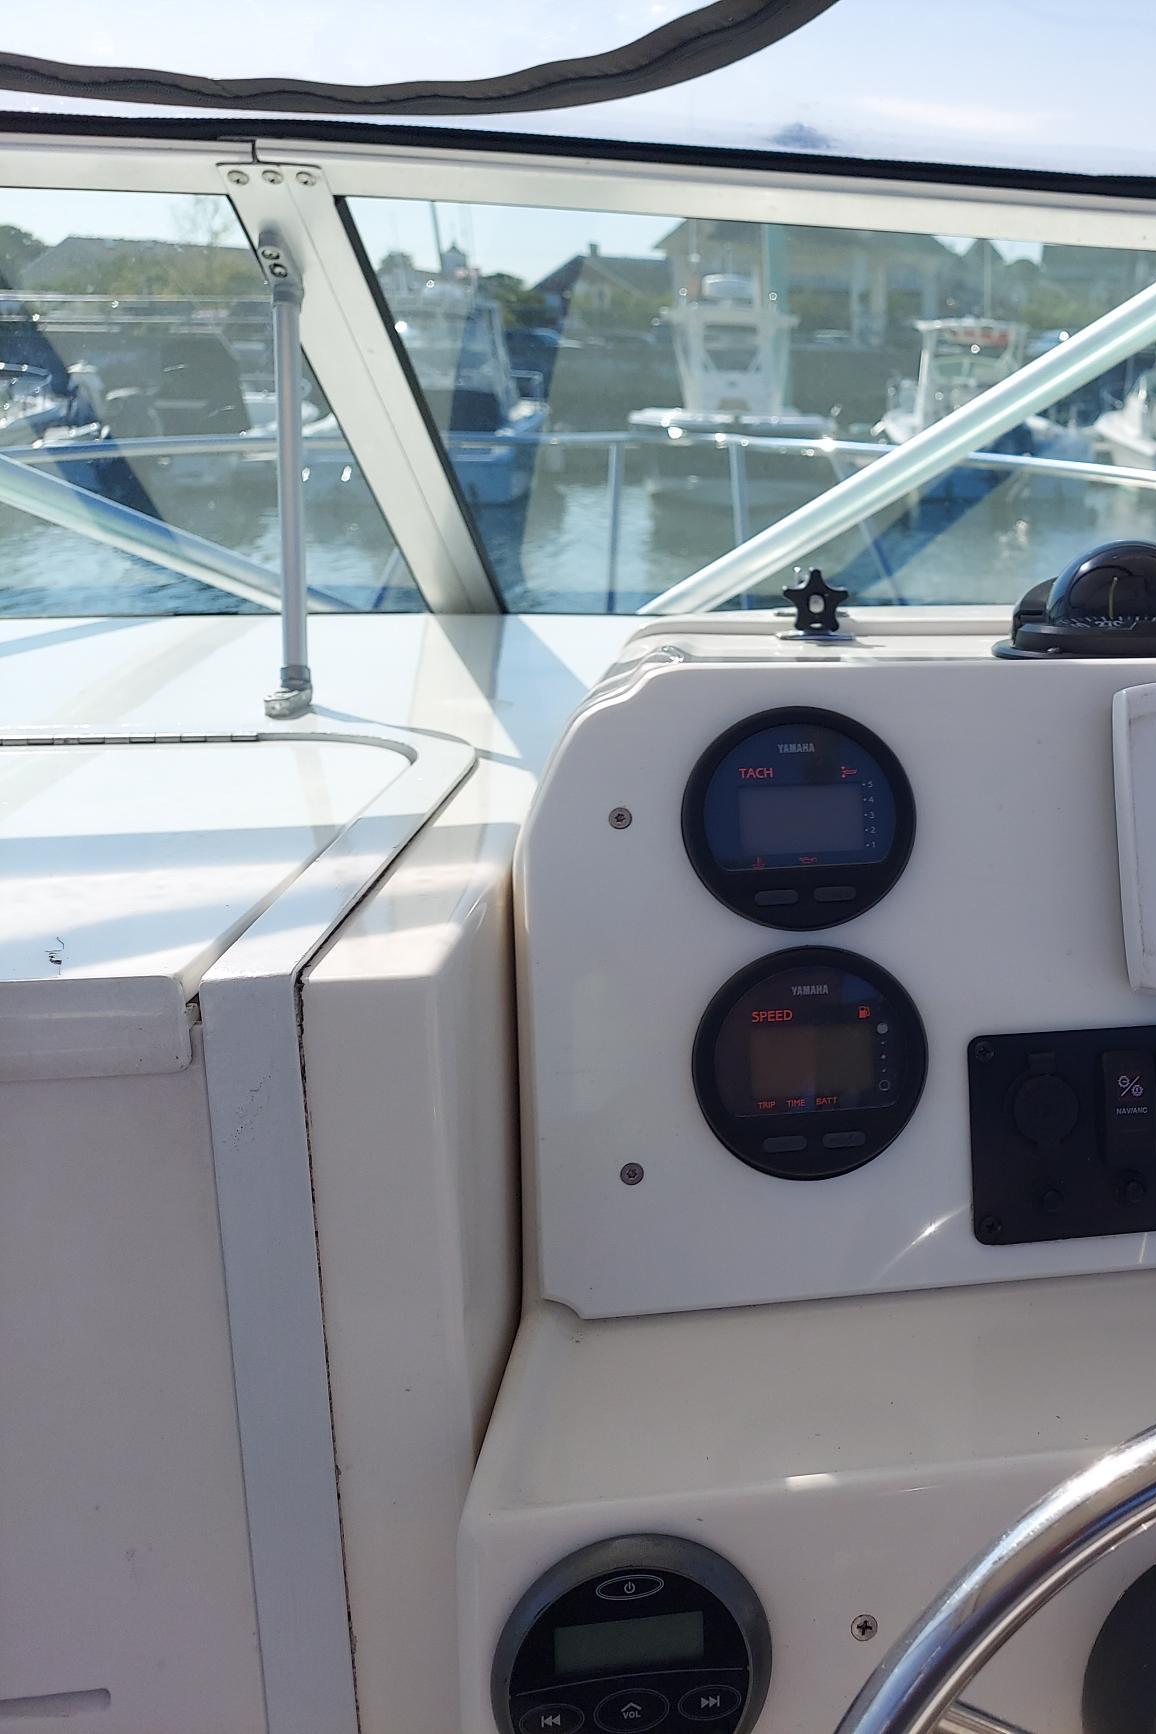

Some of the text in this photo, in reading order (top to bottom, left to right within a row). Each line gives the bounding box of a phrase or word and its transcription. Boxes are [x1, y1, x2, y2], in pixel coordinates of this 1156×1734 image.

[777, 743, 815, 753] YAMAHA
[738, 767, 774, 779] TACH
[791, 984, 829, 996] YAMAHA
[751, 1009, 793, 1023] SPEED
[757, 1100, 776, 1110] TRIP
[786, 1099, 806, 1107] TIME
[816, 1096, 838, 1105] BATT
[623, 1710, 641, 1720] VOL
